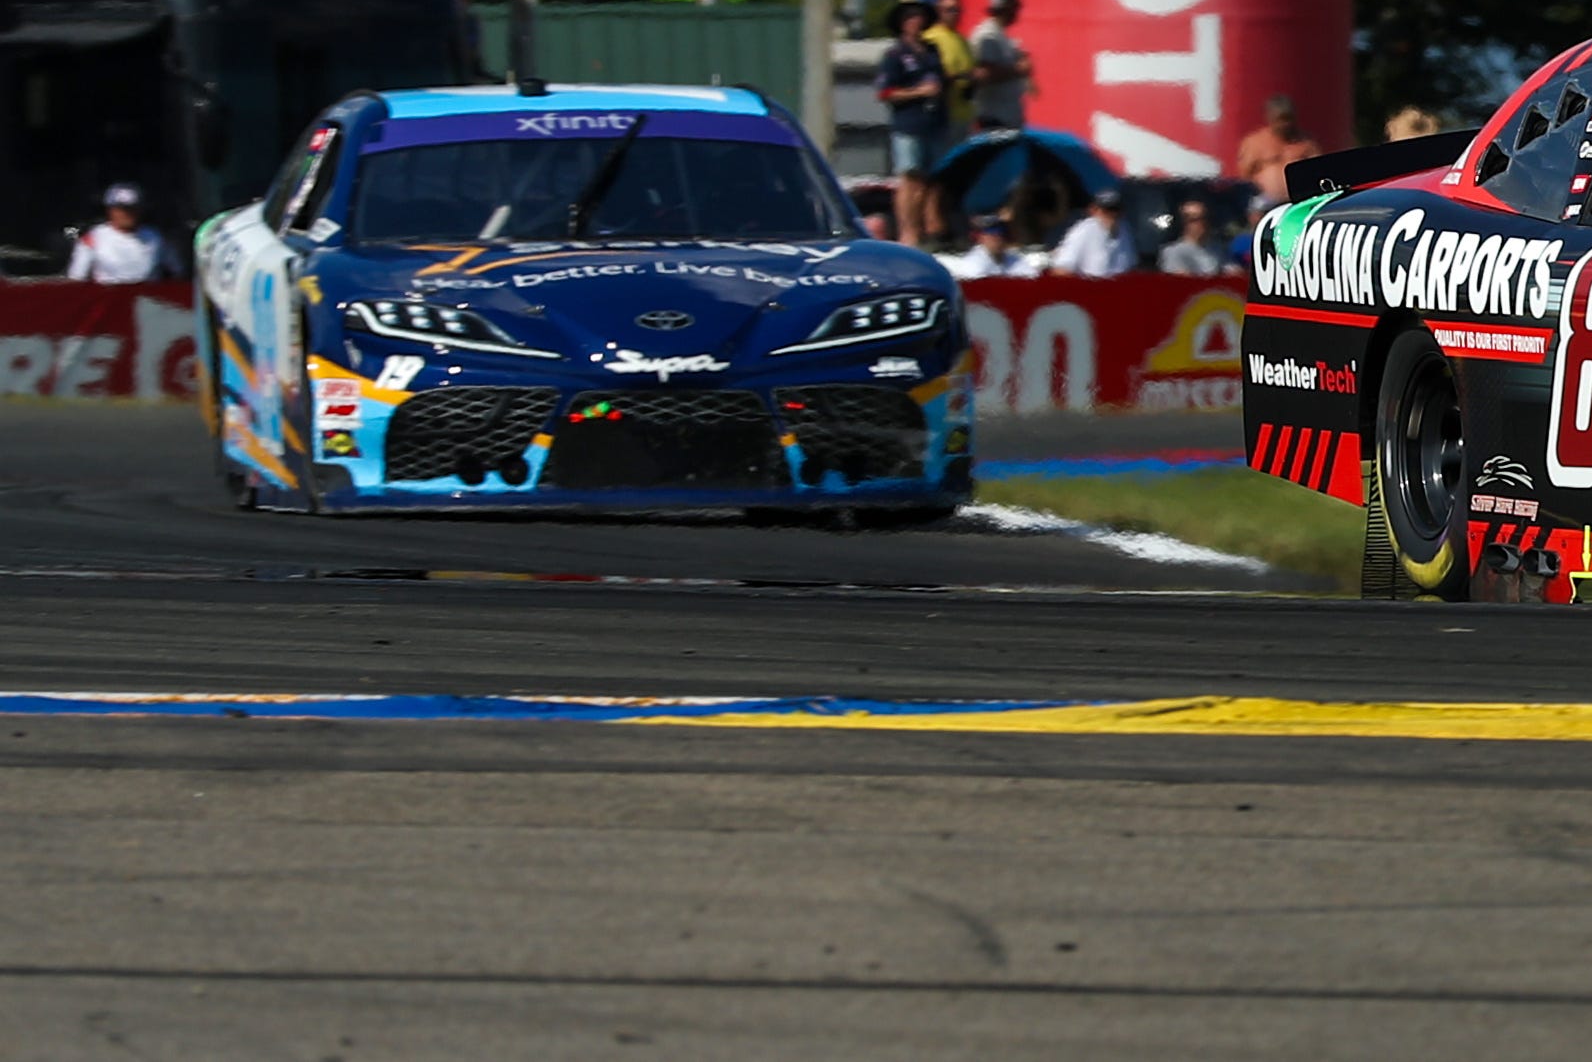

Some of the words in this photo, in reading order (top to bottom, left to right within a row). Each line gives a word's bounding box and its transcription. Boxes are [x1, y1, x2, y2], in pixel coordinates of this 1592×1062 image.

[654, 261, 738, 278] Live
[1380, 208, 1564, 319] CARPORTS
[1433, 328, 1466, 348] QUALITY
[1466, 331, 1476, 349] IS
[1475, 332, 1492, 350] OUR
[1491, 333, 1513, 352] FIRST
[1512, 334, 1546, 354] PRIORITY
[374, 354, 426, 391] 19
[1248, 353, 1357, 395] WeatherTech
